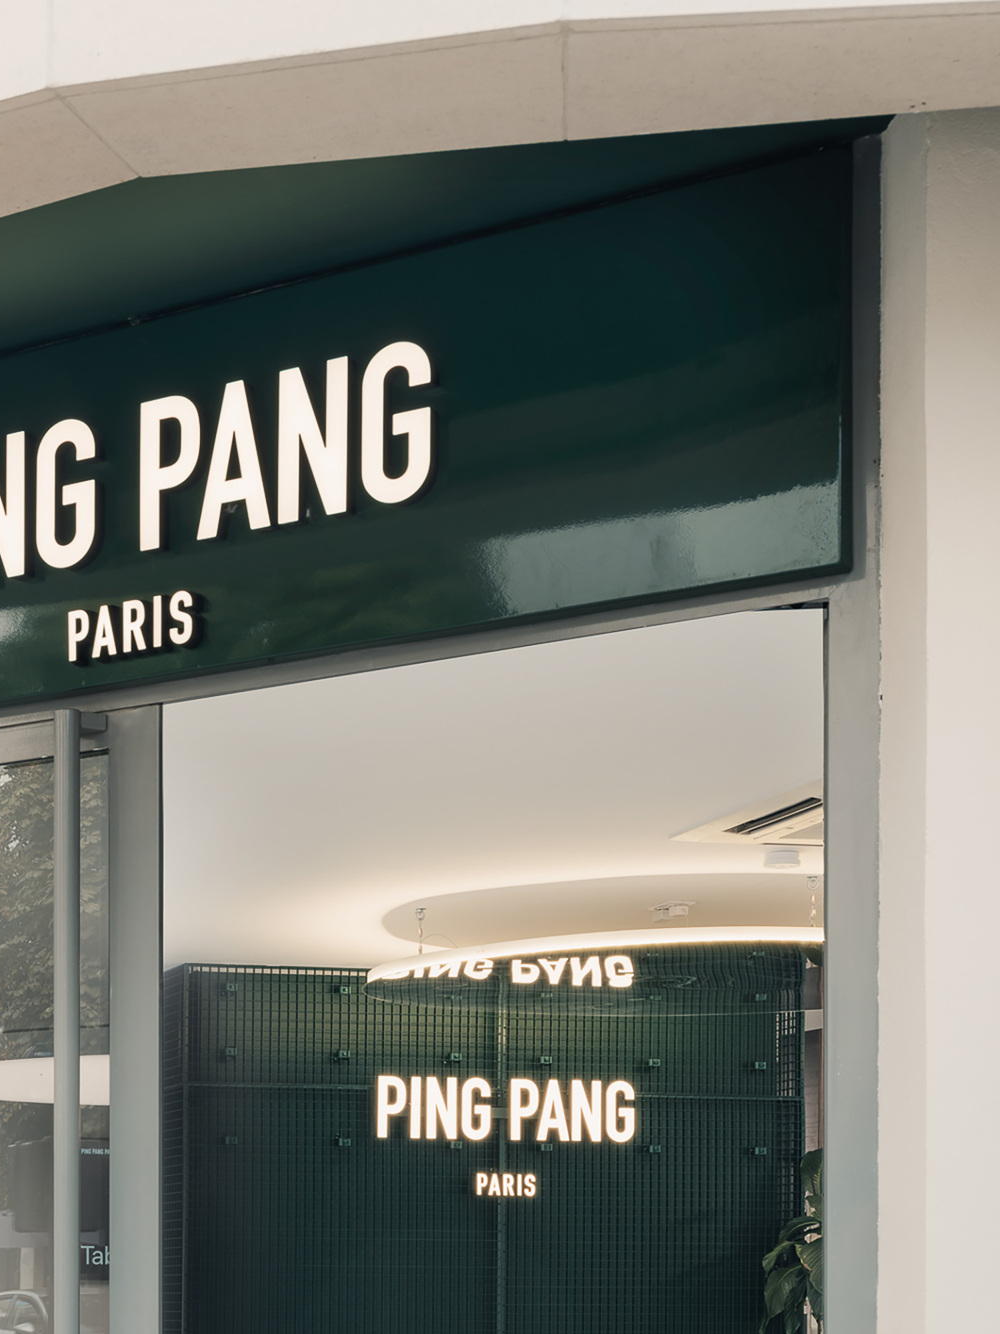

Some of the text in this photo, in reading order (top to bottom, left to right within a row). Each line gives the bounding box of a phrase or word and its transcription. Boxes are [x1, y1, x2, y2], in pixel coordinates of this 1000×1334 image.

[140, 341, 431, 552] PANG
[68, 590, 194, 662] PARIS
[376, 1075, 636, 1143] PING PANG
[475, 1172, 537, 1197] PARIS
